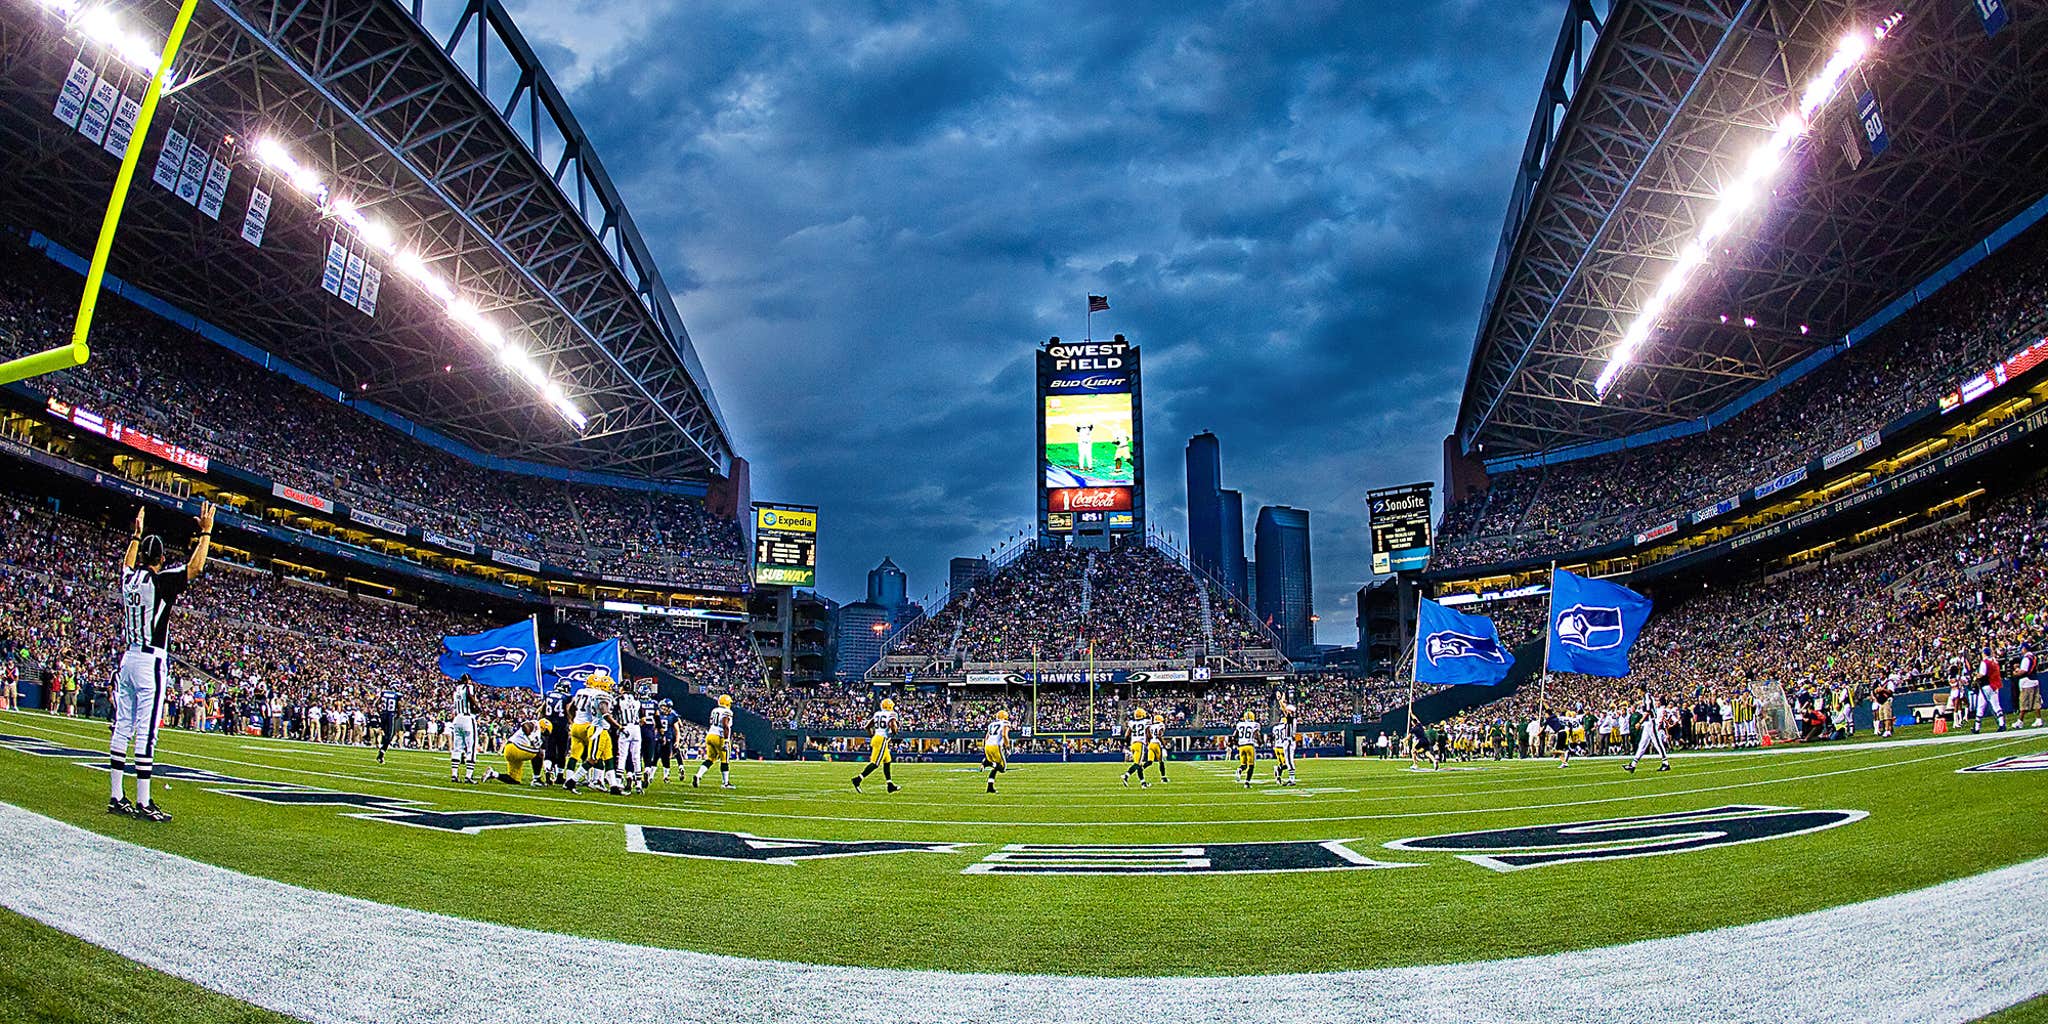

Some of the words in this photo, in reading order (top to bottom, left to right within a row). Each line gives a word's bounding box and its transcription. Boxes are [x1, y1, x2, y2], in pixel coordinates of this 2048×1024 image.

[1864, 112, 1883, 142] 80
[1049, 344, 1127, 359] QWEST
[1056, 357, 1122, 371] FIELD
[1050, 380, 1081, 388] BUD
[1385, 495, 1426, 512] SonoSite
[778, 515, 812, 527] Expedia
[760, 567, 812, 583] SUBWAY
[128, 592, 141, 606] 30
[1041, 673, 1081, 683] HAWKS
[1085, 672, 1114, 683] NEST
[545, 697, 565, 717] 64
[576, 694, 589, 712] 77
[660, 719, 669, 732] 9
[1132, 723, 1145, 737] 42
[1238, 726, 1252, 739] 36
